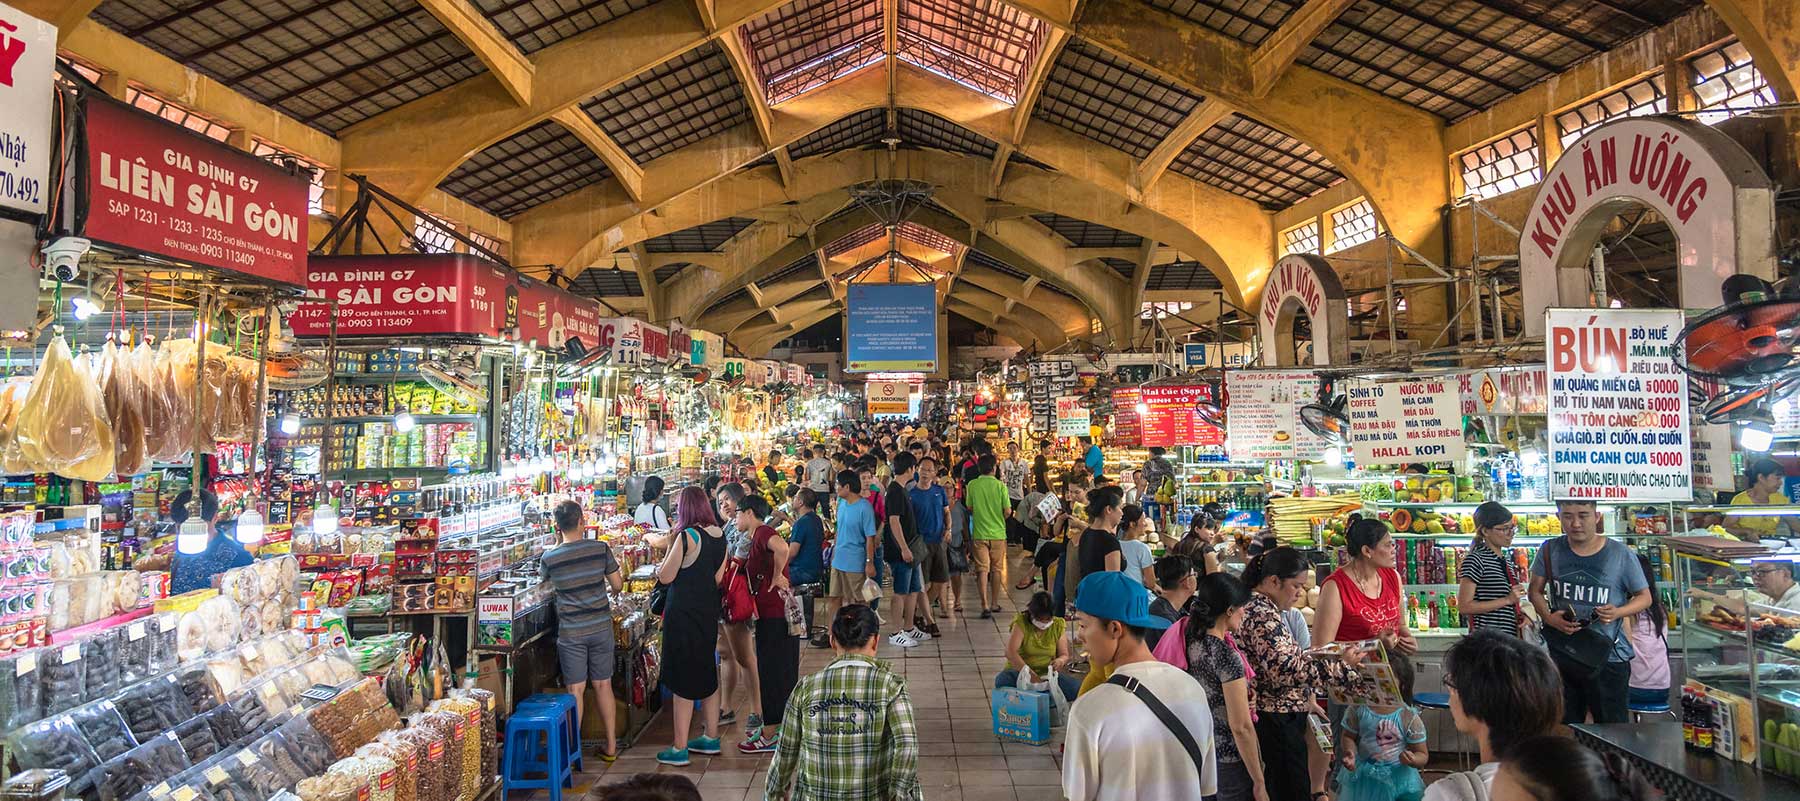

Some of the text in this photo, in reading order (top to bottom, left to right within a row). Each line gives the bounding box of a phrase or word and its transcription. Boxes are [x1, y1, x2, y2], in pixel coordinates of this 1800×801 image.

[163, 148, 259, 194] GIA ĐÌNH G7
[100, 152, 298, 243] LIÊN SÀI GÒN
[1532, 131, 1707, 259] KHU ĂN UỐNG
[108, 200, 130, 218] SẠP
[134, 206, 158, 225] 1231
[169, 216, 192, 235] 1233
[201, 226, 223, 243] 1235
[200, 243, 223, 259] 0903
[226, 249, 255, 266] 113409
[308, 269, 416, 282] GIA ĐÌNH G7
[337, 282, 457, 305] SÀI GÒN
[473, 285, 487, 299] SẠP
[1264, 263, 1320, 327] KHU ĂN UỐNG
[470, 298, 489, 312] 1189
[347, 318, 373, 328] 0903
[376, 317, 413, 327] 113409
[566, 316, 579, 333] LIÊN
[579, 319, 588, 335] SÀI
[1648, 324, 1669, 340] HUẾ
[1552, 315, 1628, 374] BÚN
[1653, 362, 1669, 374] CUA
[1399, 380, 1444, 395] NƯỚC MÍA
[1553, 373, 1679, 394] MÌ QUẢNG MIẾN GÀ 50000
[1161, 387, 1179, 395] Cúc
[1180, 386, 1201, 397] (Sạp
[1350, 384, 1384, 398] SINH TỐ
[1350, 399, 1377, 408] COFFEE
[1402, 395, 1434, 406] MÍA CAM
[1553, 392, 1568, 409] HỦ
[1571, 393, 1589, 409] TÍU
[1591, 396, 1615, 410] NAM
[1617, 397, 1645, 410] VANG
[1647, 397, 1681, 412] 50000
[1352, 409, 1379, 419] RAU MÁ
[1403, 407, 1417, 417] MÍA
[1353, 422, 1367, 431] RAU
[1369, 420, 1380, 430] MÁ
[1405, 418, 1442, 428] MÍA THƠM
[1580, 411, 1605, 427] TÔM
[1608, 411, 1637, 428] CÀNG
[1354, 434, 1369, 442] RAU
[1370, 431, 1381, 441] MÁ
[1406, 429, 1421, 440] MÍA
[1438, 427, 1461, 438] RIÊNG
[1658, 429, 1683, 445] CUỐN
[1372, 444, 1446, 458] HALAL KOPI
[1555, 448, 1683, 467] BÁNH CANH CUA 50000
[1553, 471, 1571, 488] THỊT
[1620, 469, 1647, 487] NƯỚNG
[1649, 474, 1670, 490] CHẠO
[1672, 470, 1688, 488] TÔM
[1569, 487, 1602, 498] CANH
[482, 604, 509, 613] LUWAK
